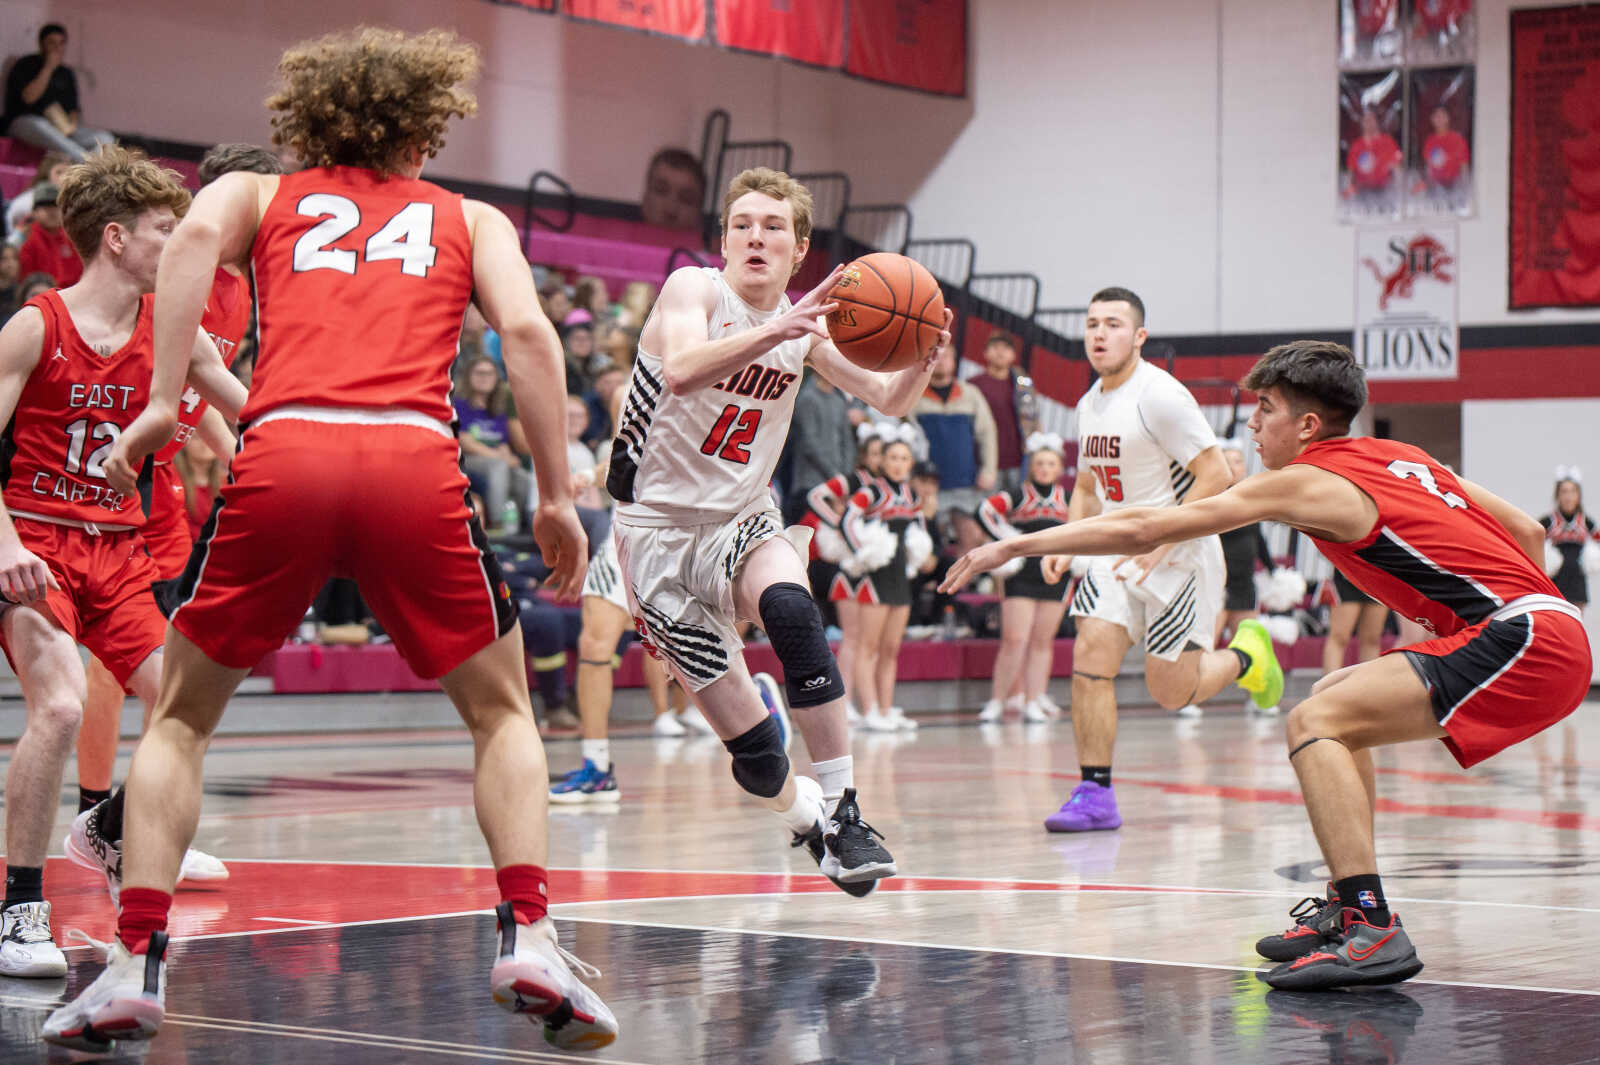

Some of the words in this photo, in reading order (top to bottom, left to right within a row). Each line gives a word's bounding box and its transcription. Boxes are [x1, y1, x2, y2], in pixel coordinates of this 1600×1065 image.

[292, 193, 438, 278] 24
[1359, 328, 1453, 371] LIONS
[69, 383, 135, 411] EAST
[64, 418, 122, 480] 12
[700, 403, 763, 465] 12
[32, 471, 125, 513] CARTER
[1386, 459, 1470, 510] 2
